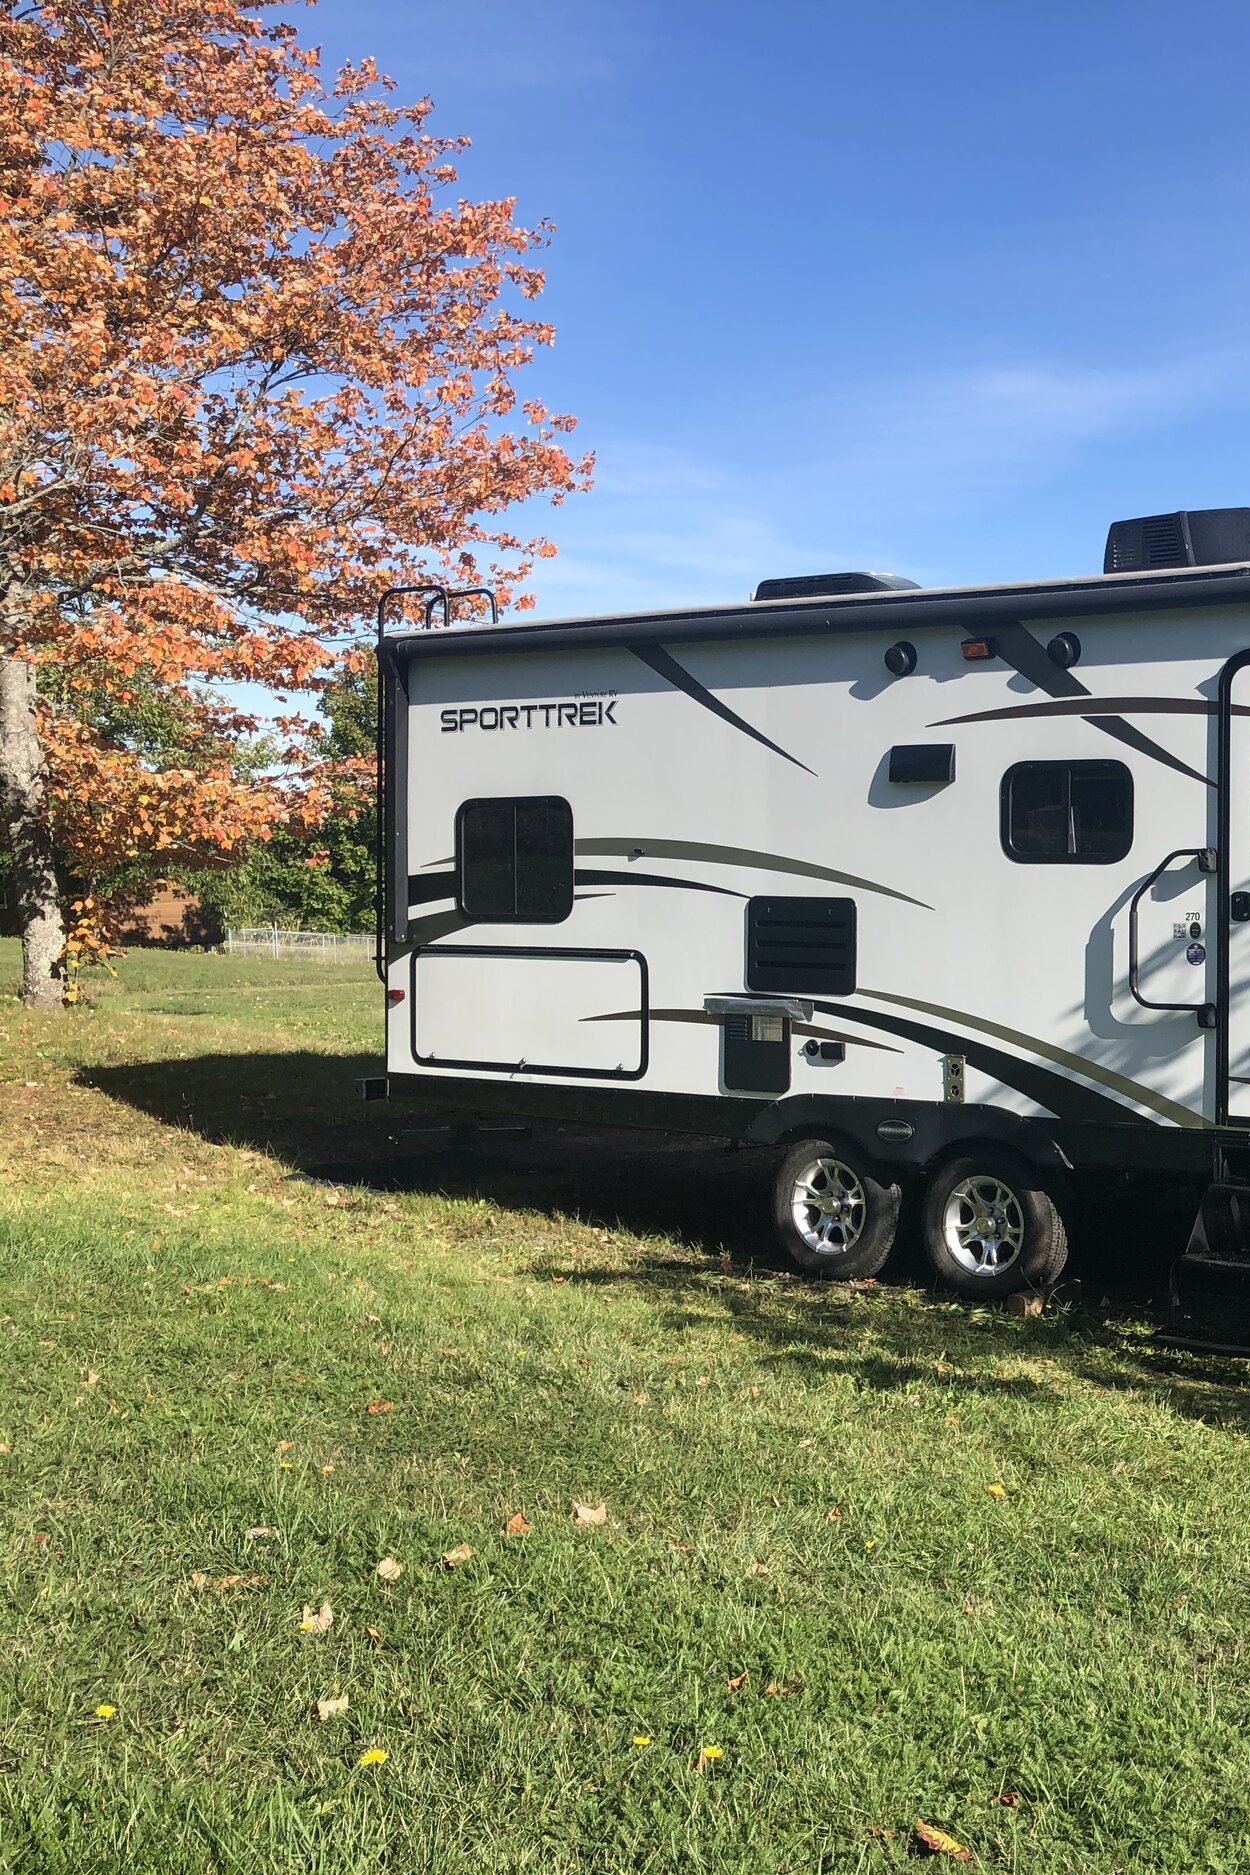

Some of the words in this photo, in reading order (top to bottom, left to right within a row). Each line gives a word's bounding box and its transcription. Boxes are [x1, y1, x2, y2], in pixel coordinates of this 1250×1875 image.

[608, 689, 619, 698] RV
[440, 700, 619, 733] SPORTTREK
[1185, 912, 1200, 921] 270
